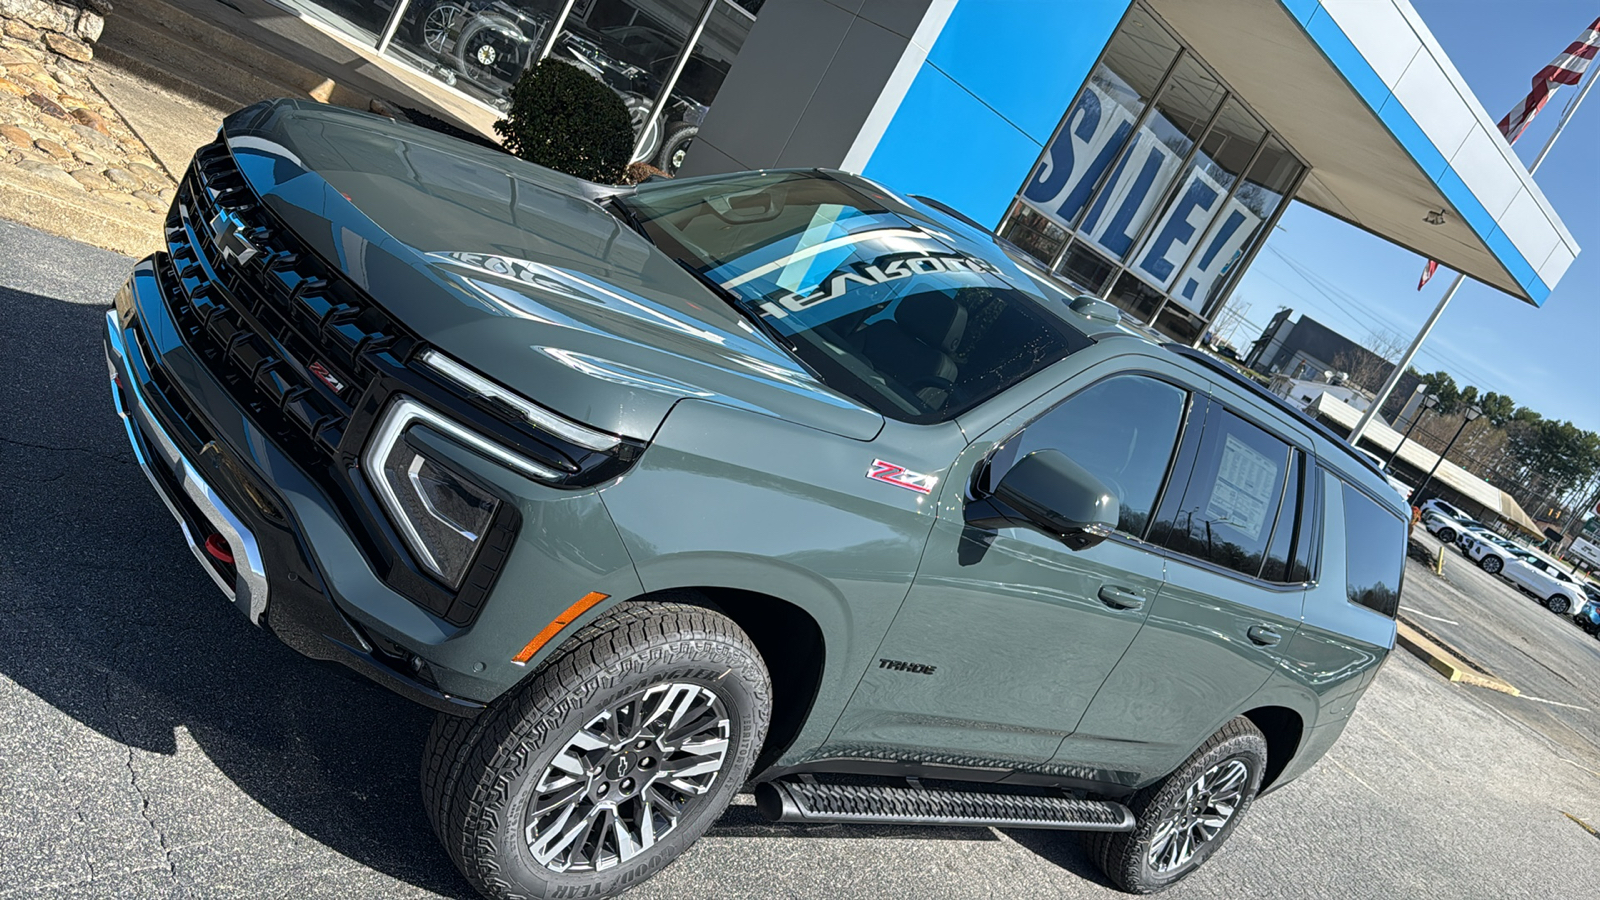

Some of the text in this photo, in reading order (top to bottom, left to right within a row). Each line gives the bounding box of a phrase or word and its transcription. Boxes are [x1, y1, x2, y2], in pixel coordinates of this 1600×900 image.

[1024, 87, 1247, 301] SALE!
[308, 361, 344, 393] Z71
[865, 458, 939, 495] Z71
[879, 658, 937, 675] TAHOE
[595, 668, 720, 710] WRANGLER
[552, 844, 677, 899] GOODYEAR
